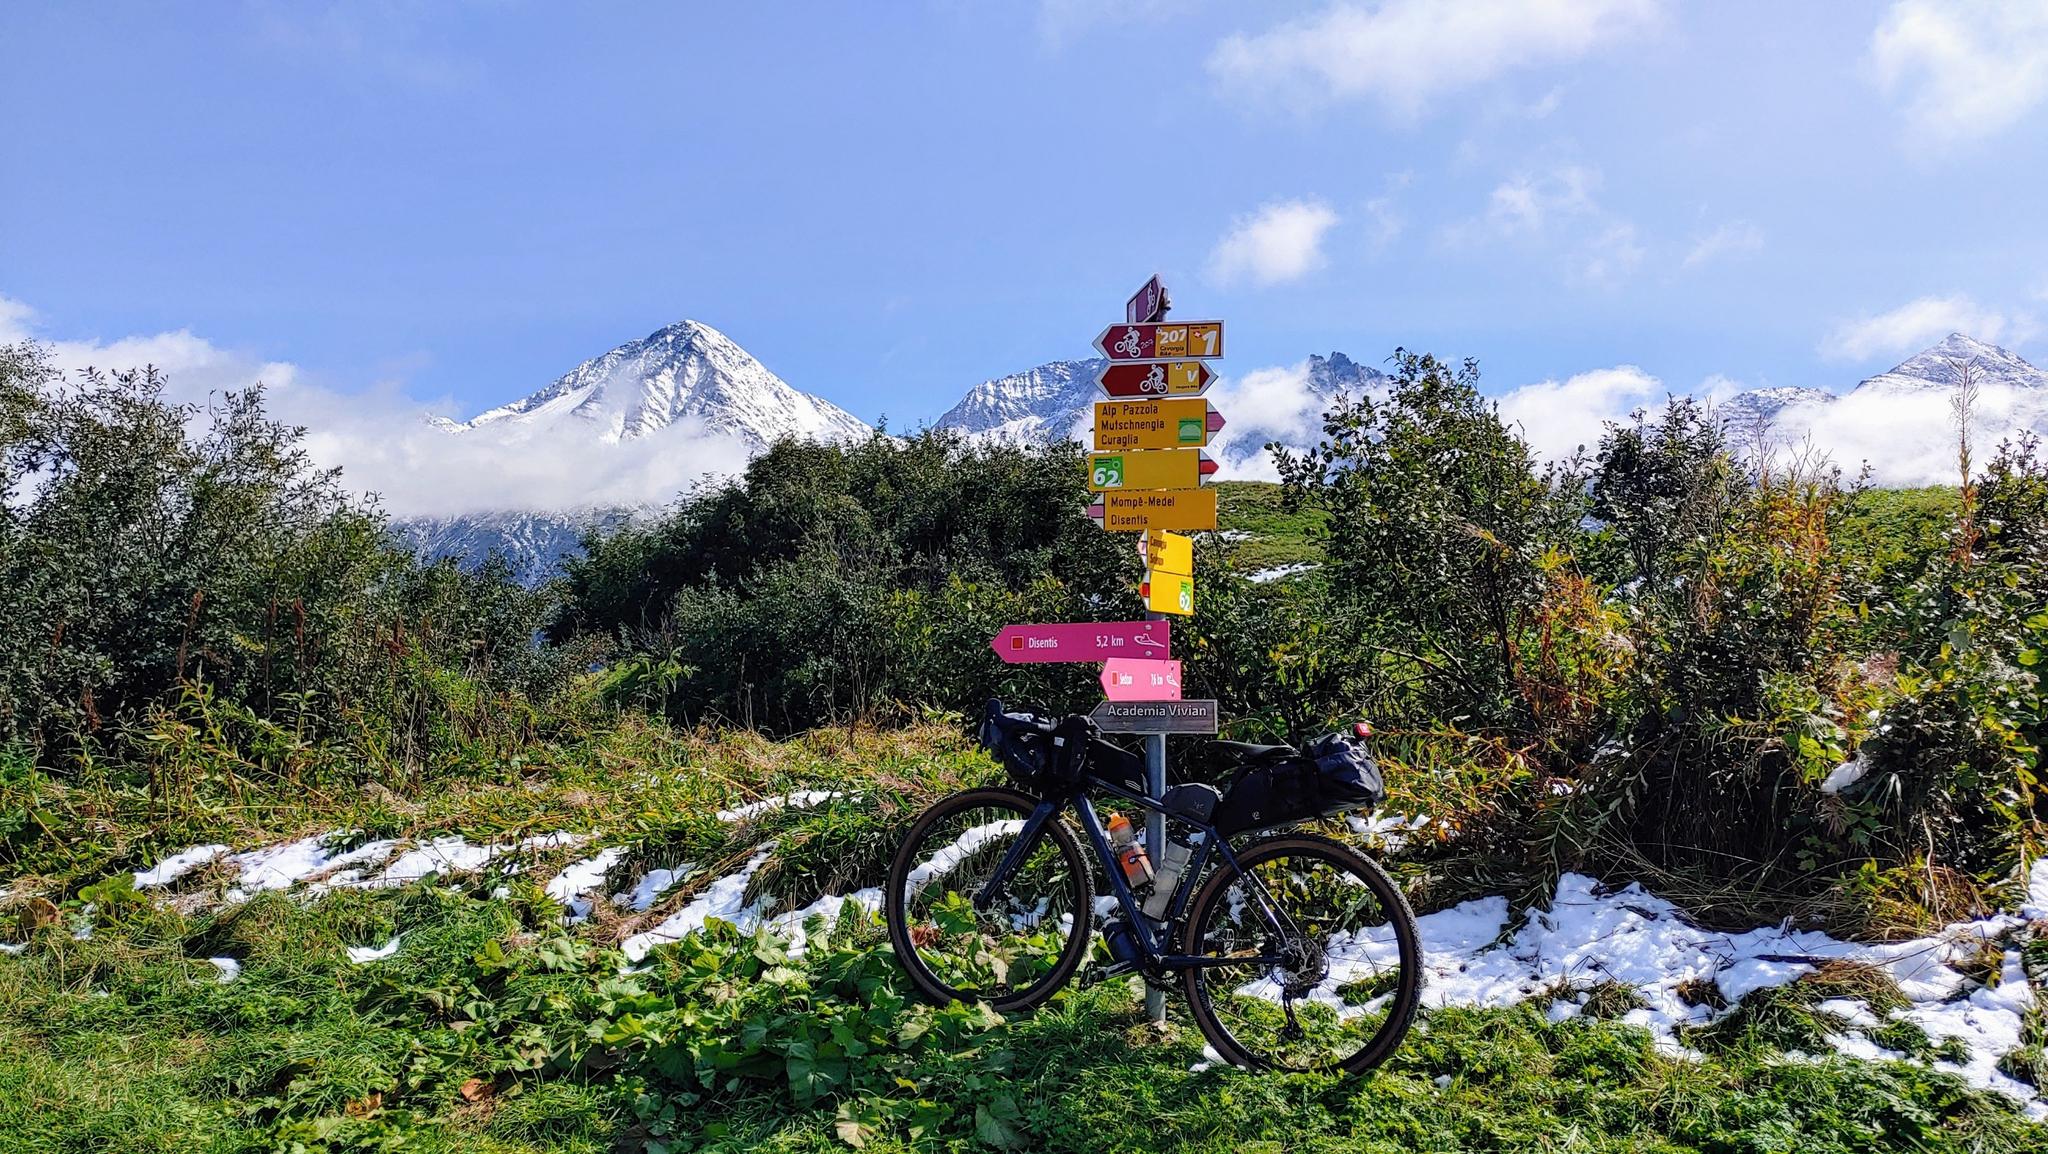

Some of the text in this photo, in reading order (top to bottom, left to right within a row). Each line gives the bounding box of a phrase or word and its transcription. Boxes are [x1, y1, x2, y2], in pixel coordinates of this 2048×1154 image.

[1159, 328, 1187, 344] 207
[1202, 330, 1217, 356] 1
[1102, 404, 1158, 418] Alp Pazzola
[1101, 419, 1165, 431] Mutschnengia
[1101, 434, 1139, 447] Curaglia
[1093, 467, 1122, 488] 62
[1111, 514, 1149, 526] Disentis
[1028, 635, 1124, 649] Disentis 5,2 km
[1107, 704, 1207, 716] Academia Vivian
